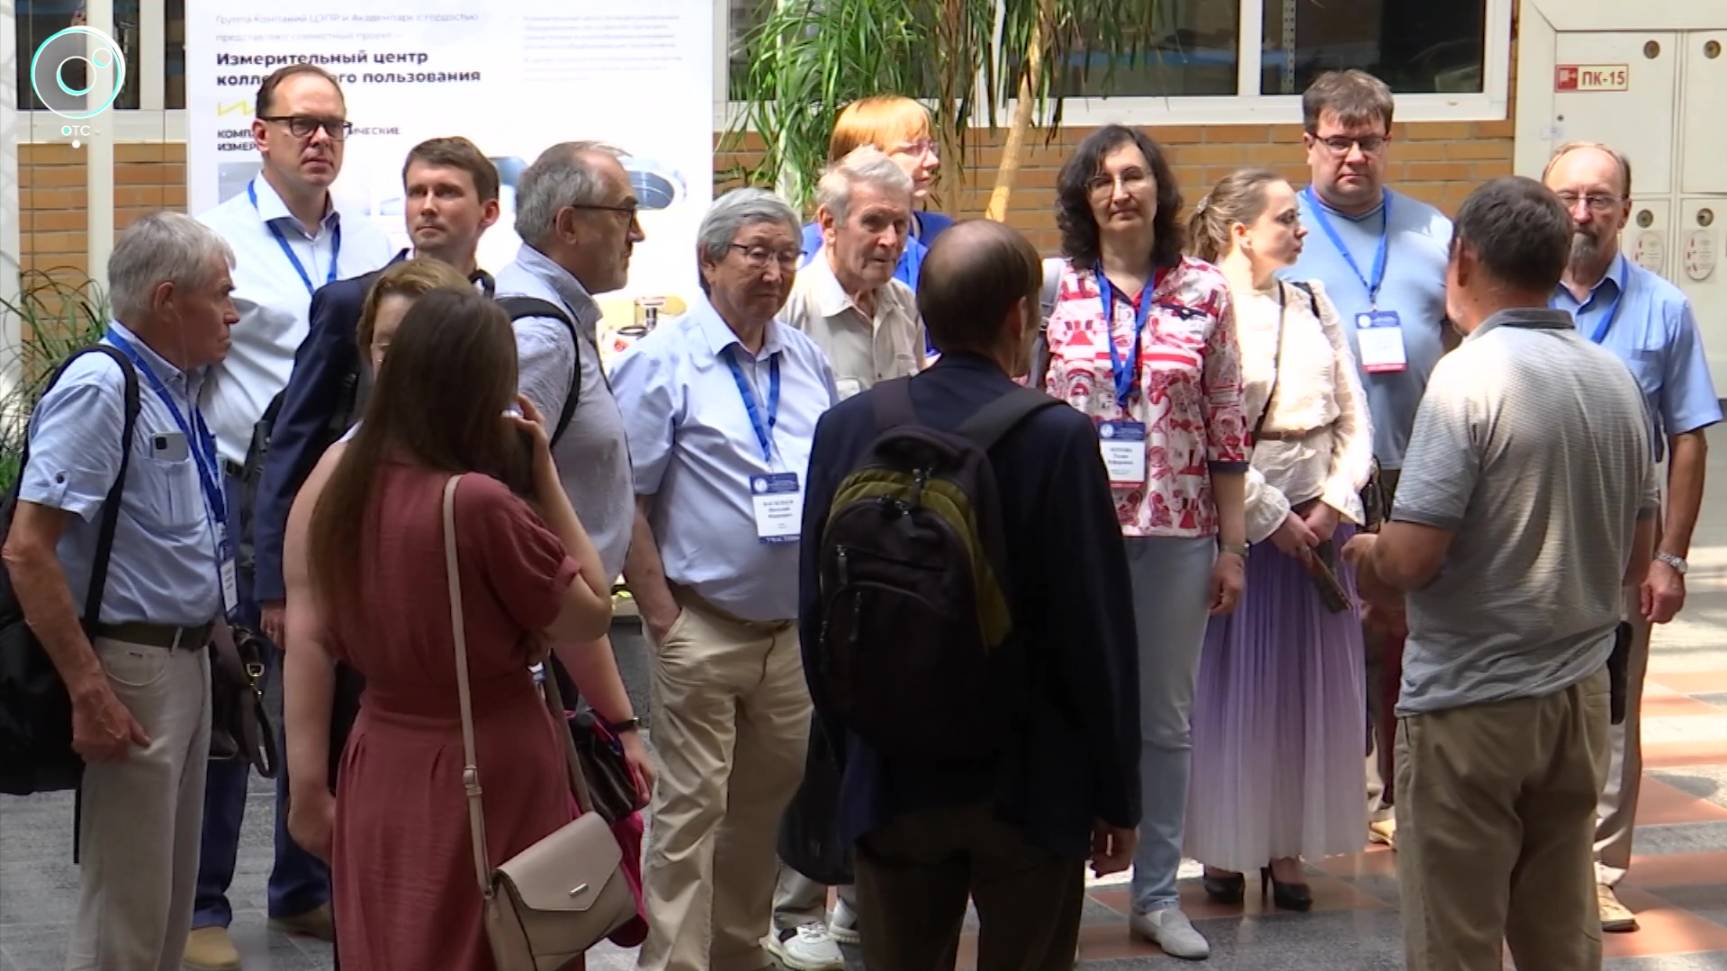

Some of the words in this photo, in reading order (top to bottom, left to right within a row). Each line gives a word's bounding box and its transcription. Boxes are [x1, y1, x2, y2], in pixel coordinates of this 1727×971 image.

[216, 50, 368, 68] Измерительный
[373, 52, 429, 66] центр
[362, 70, 481, 84] пользования
[1581, 70, 1626, 86] ПК-15
